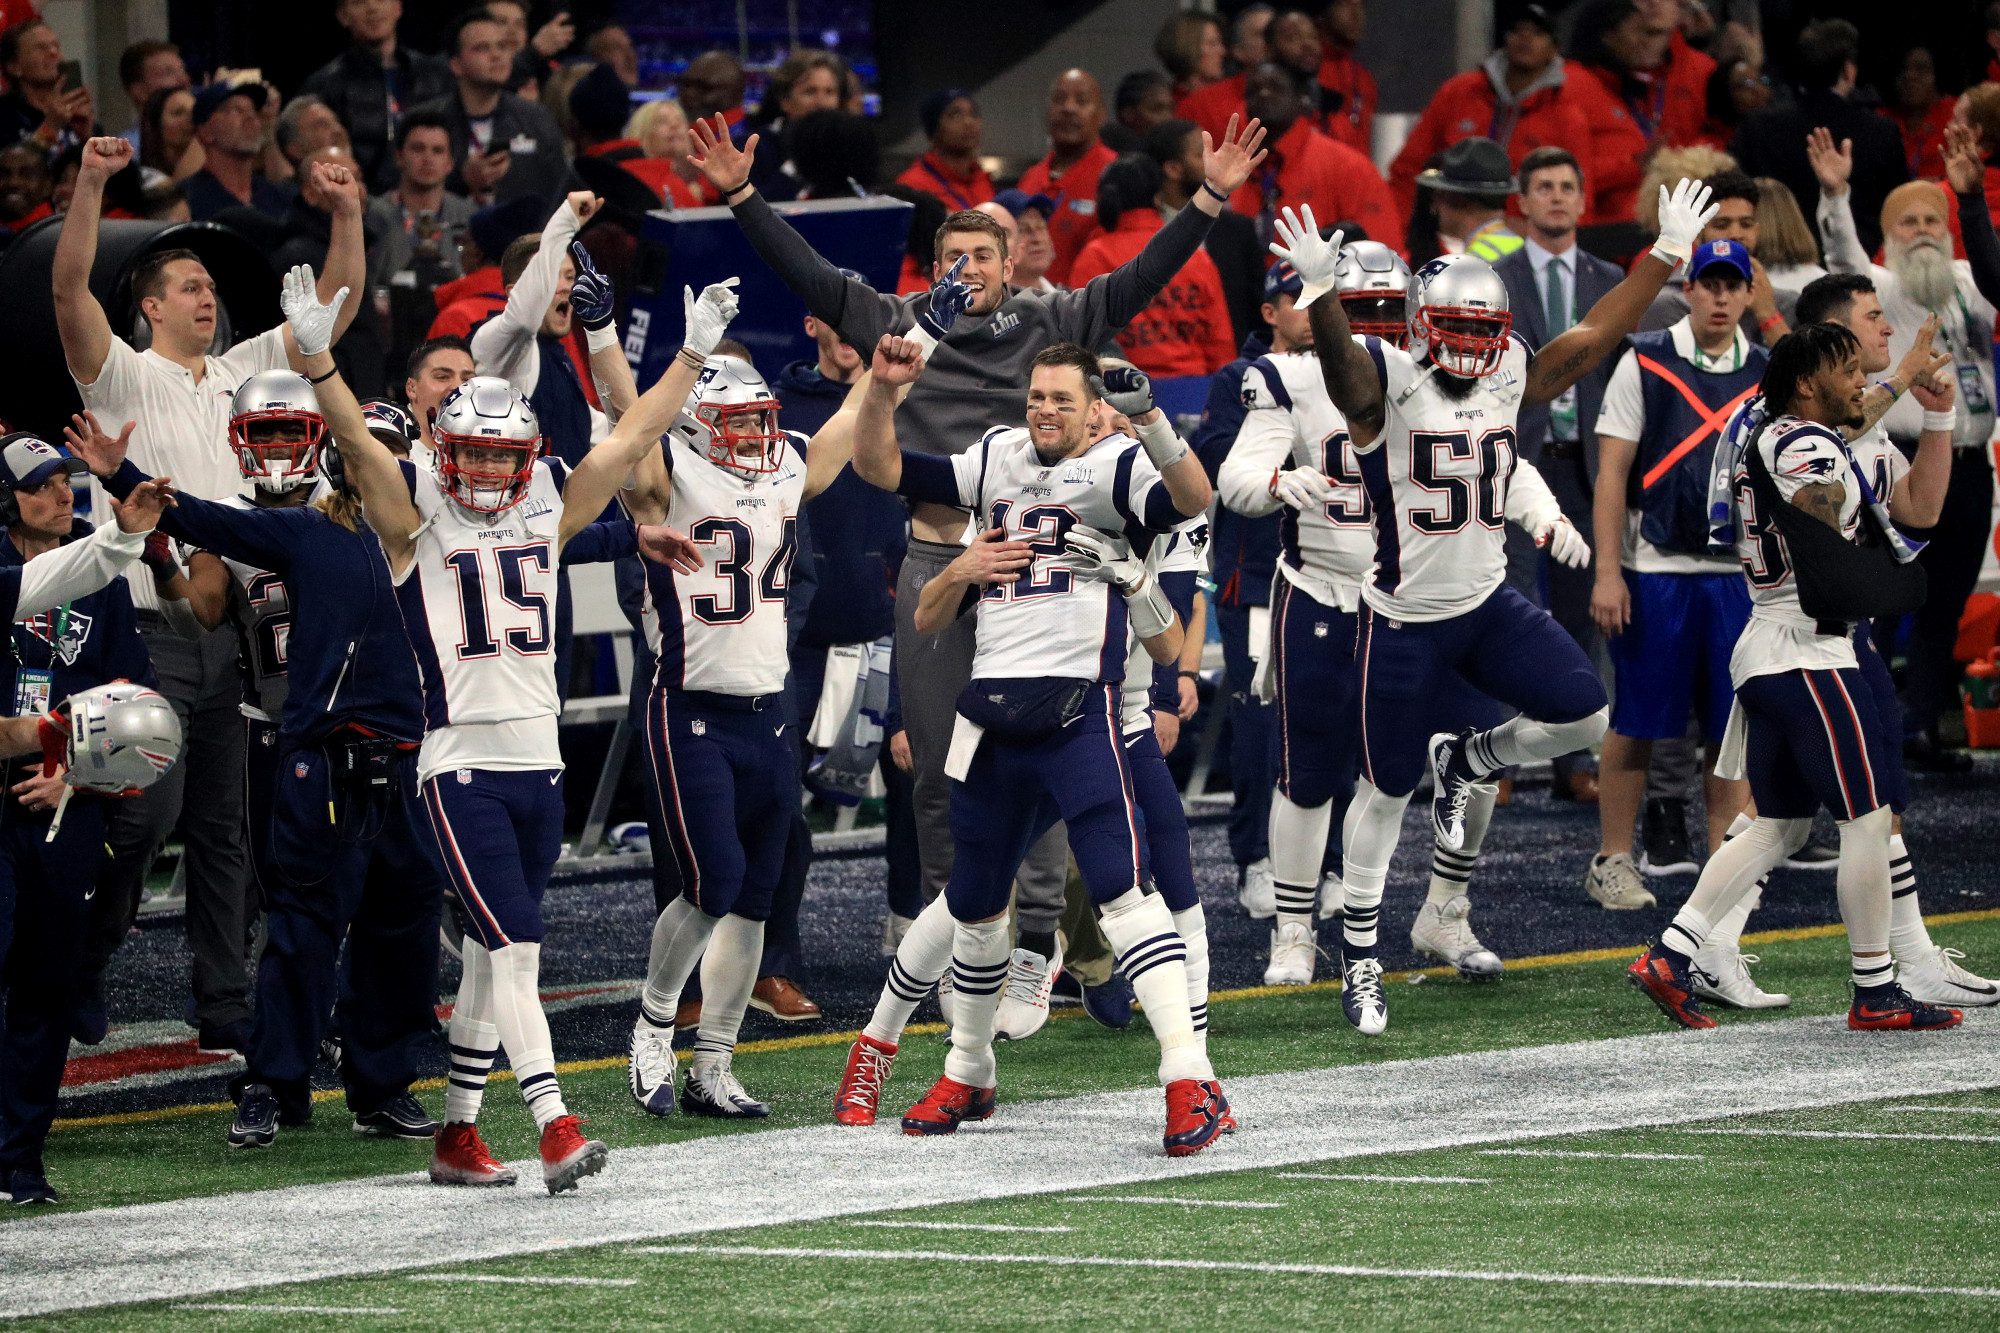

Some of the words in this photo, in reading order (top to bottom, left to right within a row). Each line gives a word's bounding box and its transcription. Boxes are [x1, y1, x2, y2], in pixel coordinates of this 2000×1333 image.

[1455, 409, 1484, 420] PATRIOTS
[481, 428, 502, 437] PATRIOTS
[1409, 425, 1518, 535] 50
[1020, 486, 1052, 497] PATRIOTS
[736, 499, 766, 509] PATRIOTS
[478, 530, 514, 541] PATRIOTS
[979, 499, 1081, 602] 12
[690, 516, 798, 626] 34
[444, 541, 552, 661] 15
[89, 715, 107, 735] 11
[1436, 743, 1453, 777] NIKE
